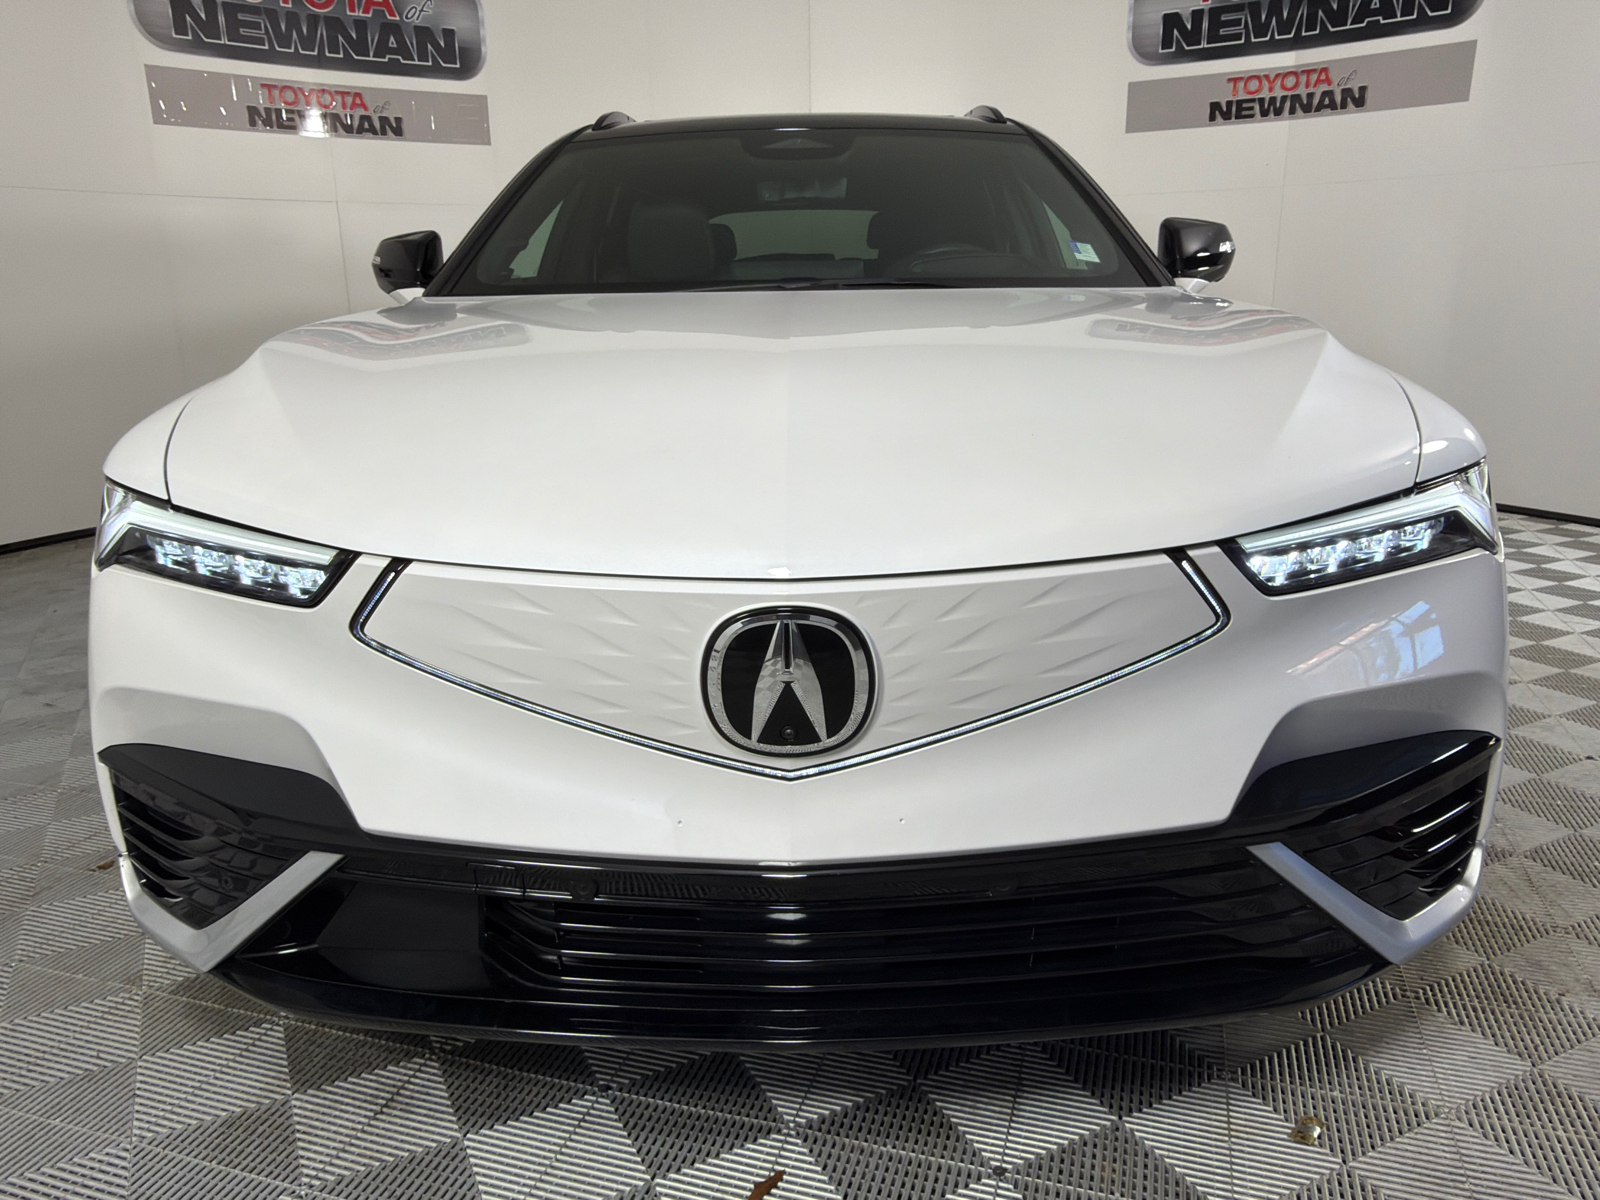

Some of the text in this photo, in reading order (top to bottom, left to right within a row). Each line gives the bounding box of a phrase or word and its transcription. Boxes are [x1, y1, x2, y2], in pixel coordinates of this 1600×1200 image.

[404, 0, 433, 21] of
[170, 0, 460, 68] NEWNAN
[1227, 66, 1358, 97] TOYOTA of
[260, 83, 391, 115] TOYOTA of
[1208, 85, 1368, 122] NEWNAN
[246, 105, 404, 137] NENAN
